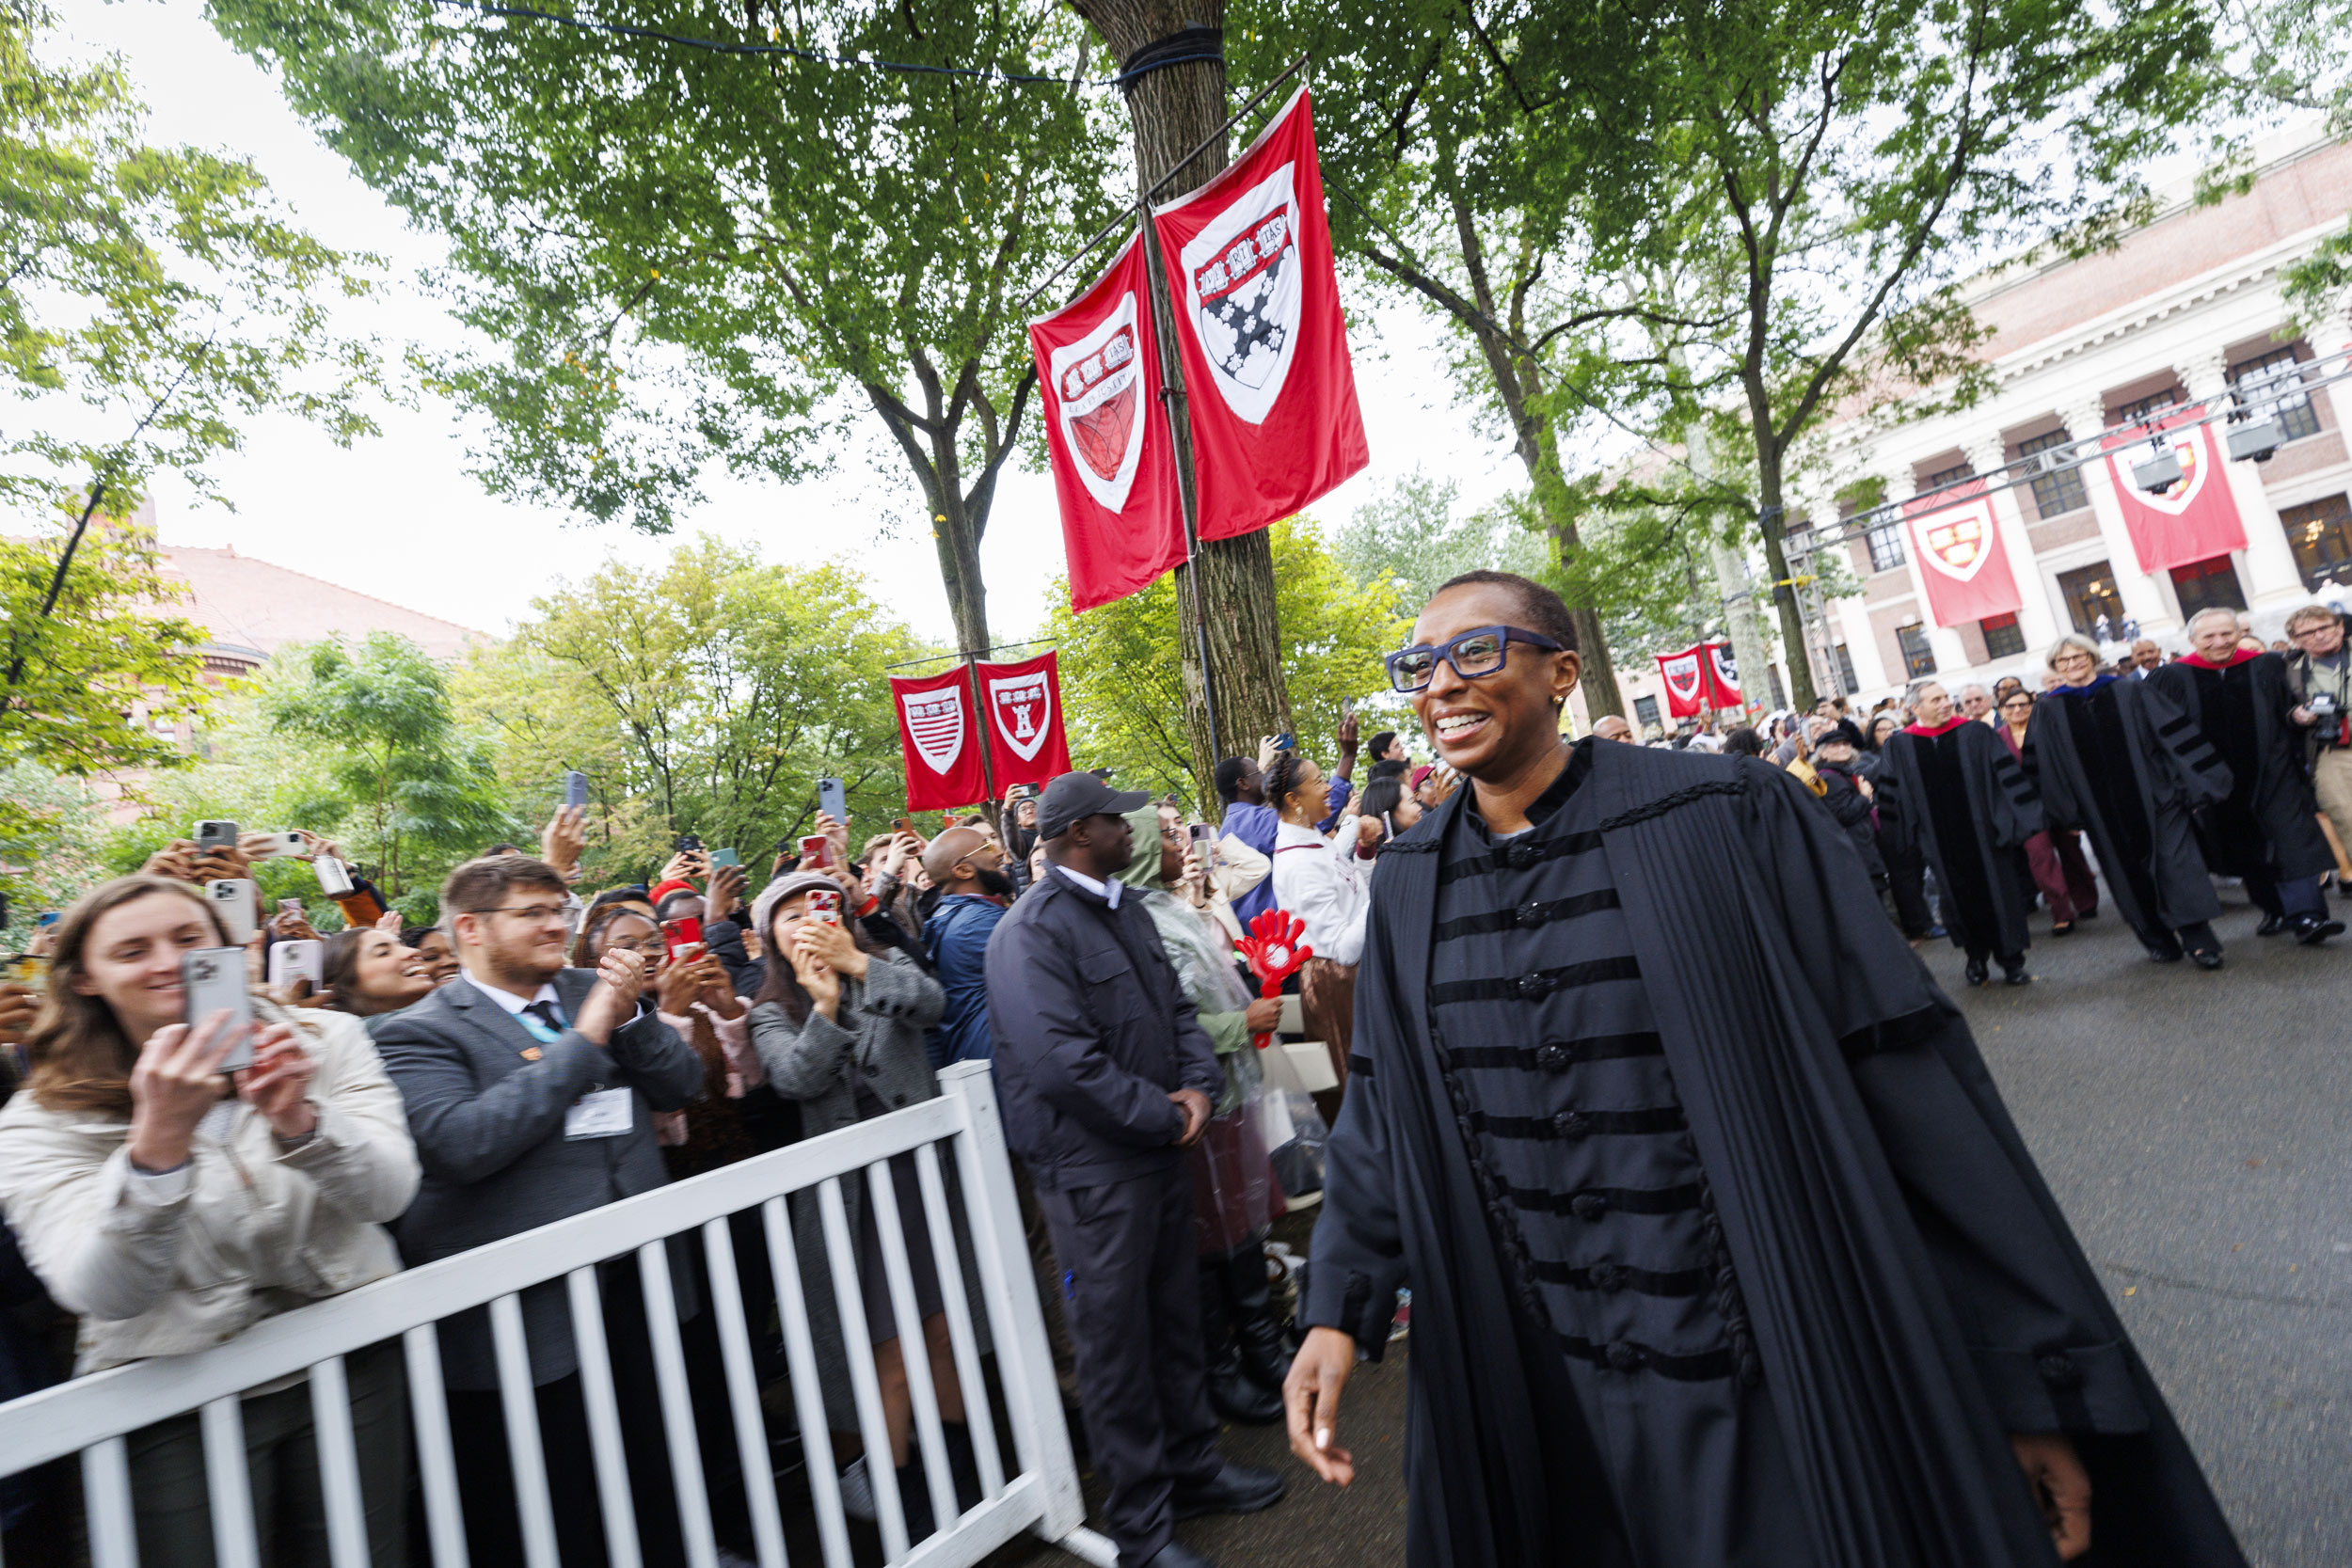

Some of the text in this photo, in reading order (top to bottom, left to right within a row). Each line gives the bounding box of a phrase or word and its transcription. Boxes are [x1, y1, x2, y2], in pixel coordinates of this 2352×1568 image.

[1232, 247, 1247, 265] RI
[1263, 223, 1282, 244] TAS
[1108, 341, 1125, 357] TAS
